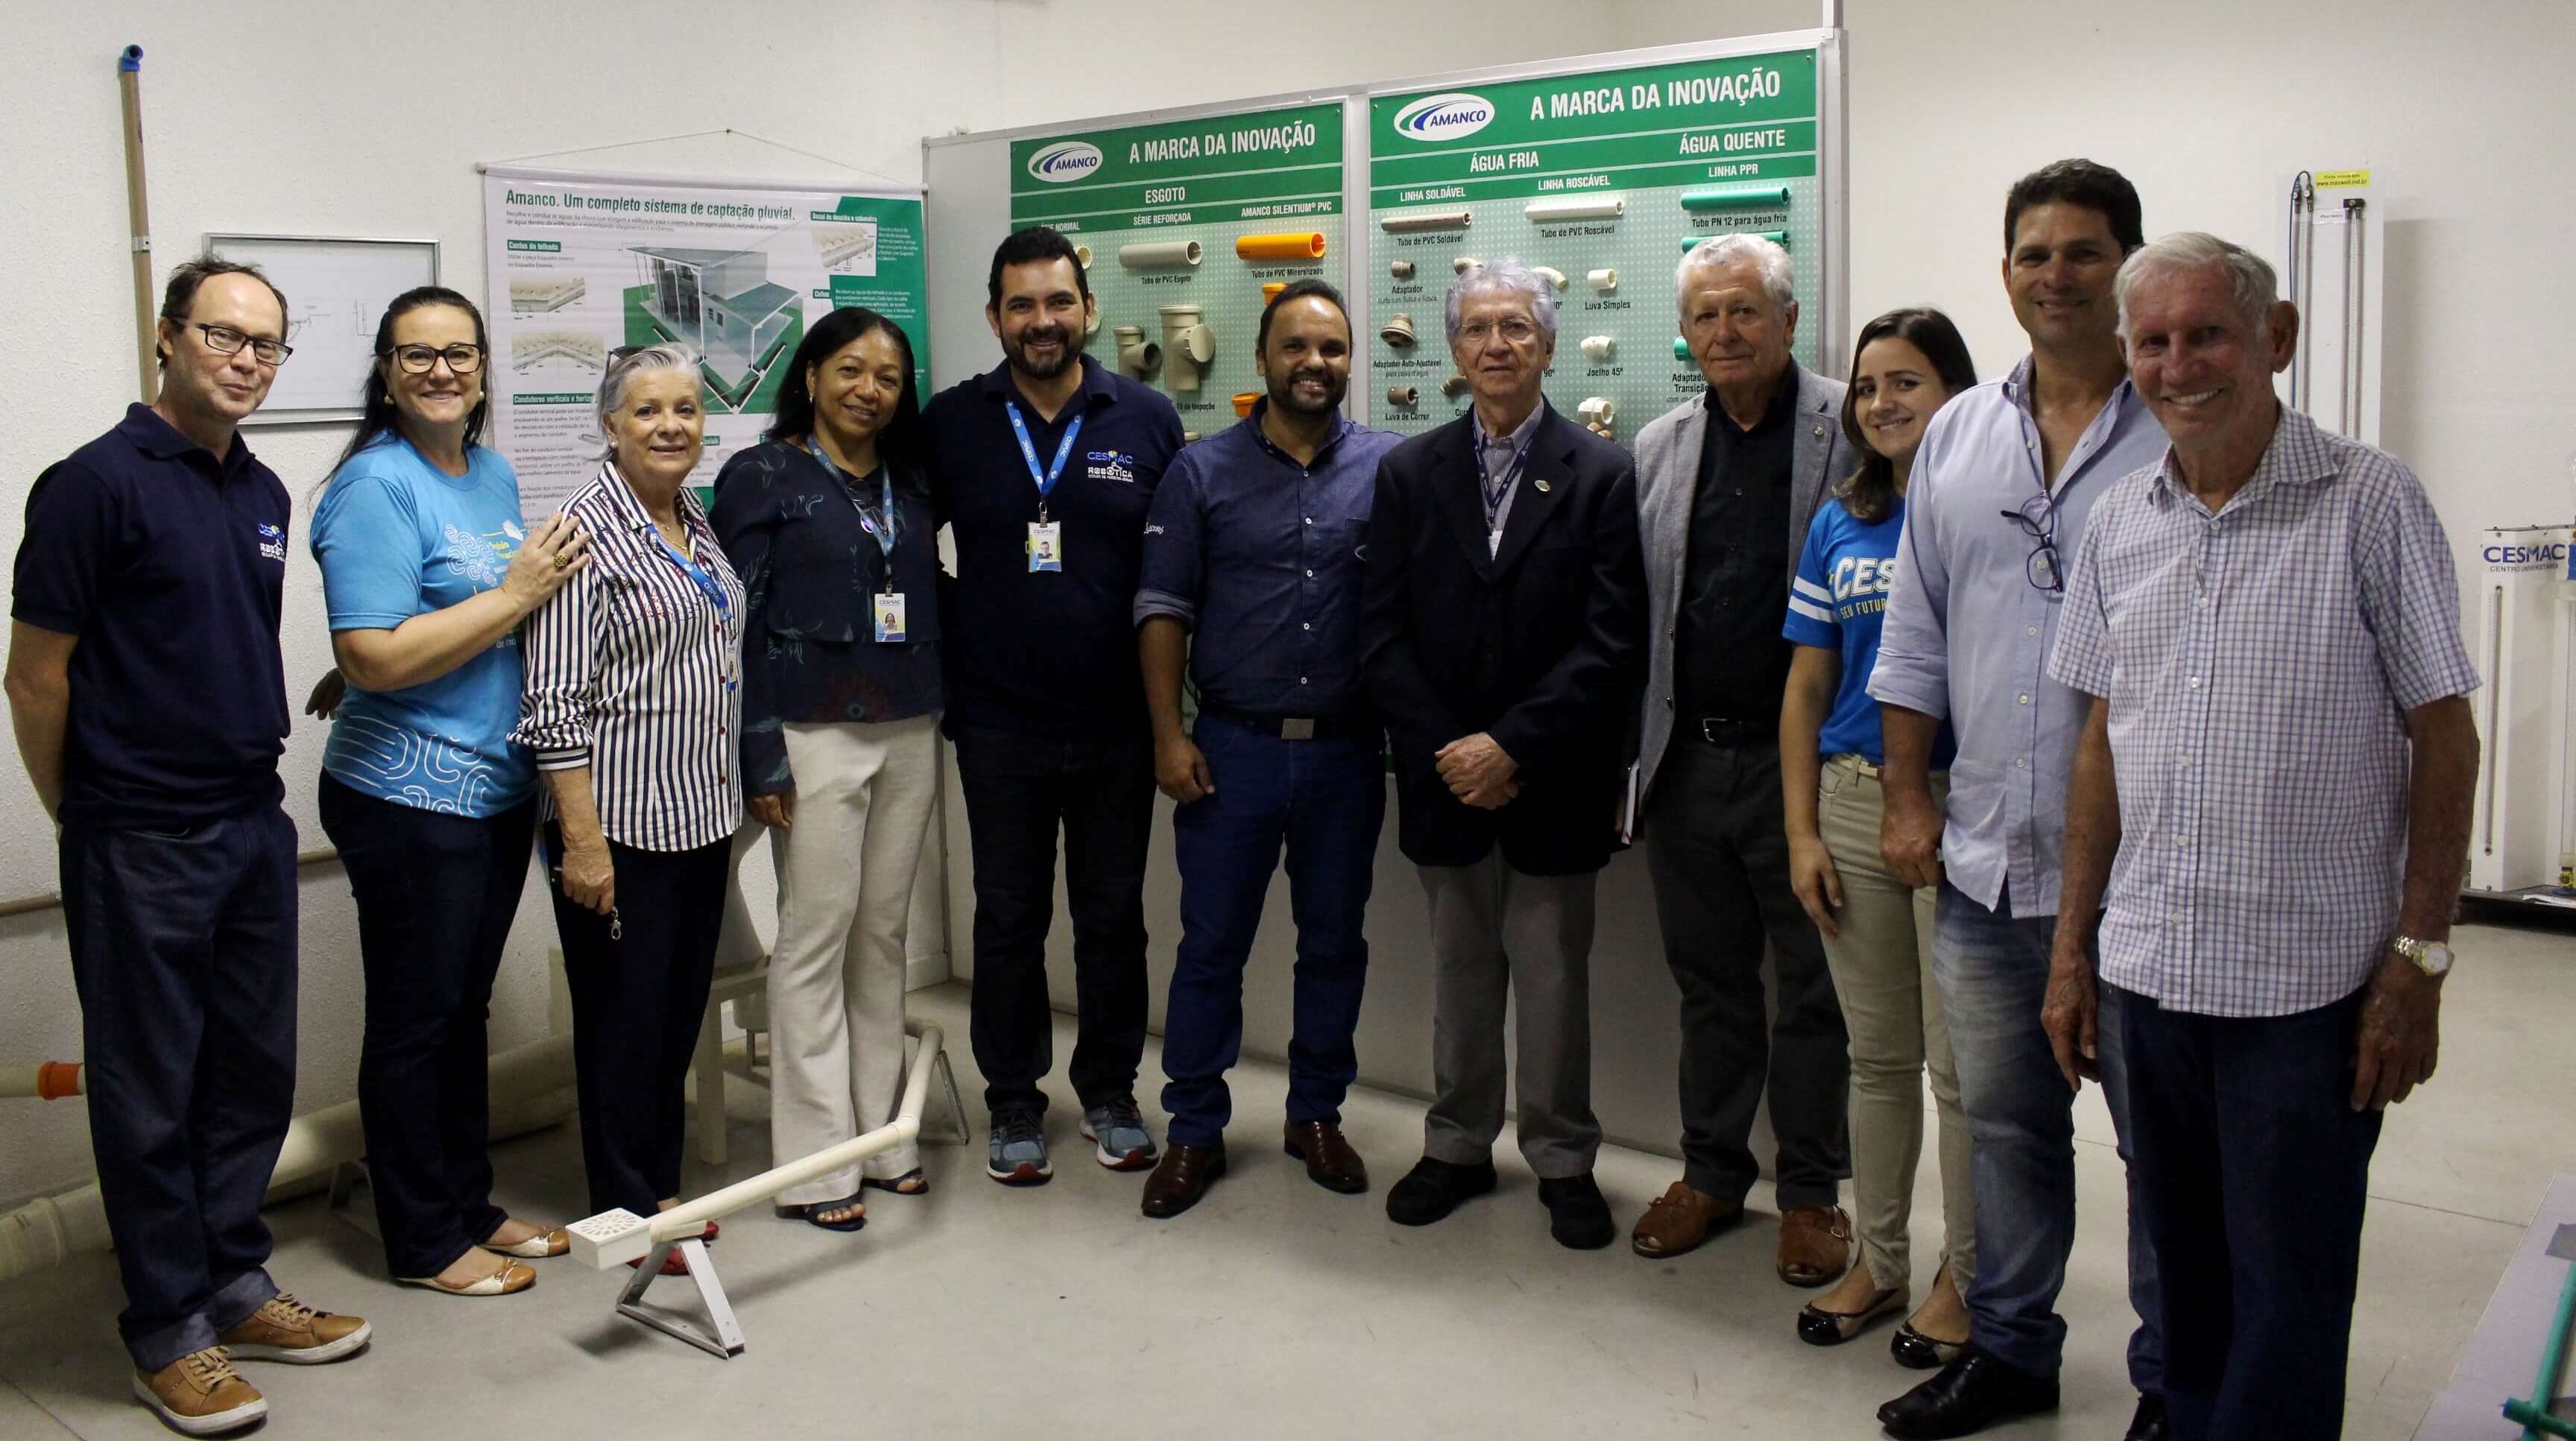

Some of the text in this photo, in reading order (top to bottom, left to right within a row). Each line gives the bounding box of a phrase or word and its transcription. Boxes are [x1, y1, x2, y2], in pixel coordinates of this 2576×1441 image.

[1530, 66, 1780, 120] A MARCA DA INOVAÇÃO
[1430, 110, 1486, 127] AMANCO
[1129, 119, 1316, 164] A MARCA DA INOVAÇÃO
[1679, 130, 1785, 154] ÁGUA QUENTE
[1055, 156, 1097, 171] AMANCO
[1470, 151, 1538, 172] ÁGUA FRIA
[1708, 164, 1758, 177] LINHA PPR
[1538, 174, 1610, 191] LINHA ROSCÁVEL
[1145, 186, 1185, 204] ESGOTO
[1400, 186, 1466, 202] LINHA SOLDÁVEL
[506, 189, 795, 221] Amanco. Um completo sistema de captação pluvial.
[1241, 206, 1270, 217] AMANCO
[1318, 201, 1331, 212] PVC
[1133, 212, 1191, 226] SÉRIE REFORÇADA
[1692, 213, 1787, 228] Tubo PN 12 para água fria
[1541, 225, 1614, 238] Tubo de PVC Roscável
[1398, 238, 1412, 246] Tubo
[1423, 236, 1435, 245] PVC
[1436, 234, 1463, 244] Soldável
[1141, 277, 1154, 285] Tubo
[1174, 275, 1191, 284] Esgoto
[1252, 267, 1323, 279] Tubo de PVC Mineralizado
[1392, 285, 1423, 295] Adaptador
[1553, 301, 1562, 309] 0º
[1585, 300, 1631, 310] Luva Simples
[1373, 359, 1400, 369] Adaptador
[1587, 368, 1609, 376] Joelho
[1672, 373, 1705, 383] Adaptado
[1386, 412, 1430, 420] Luva de Correr
[1455, 409, 1468, 417] Cur
[2483, 543, 2565, 563] CESMAC
[1834, 556, 1896, 602] CES
[1855, 598, 1887, 615] FUTUR
